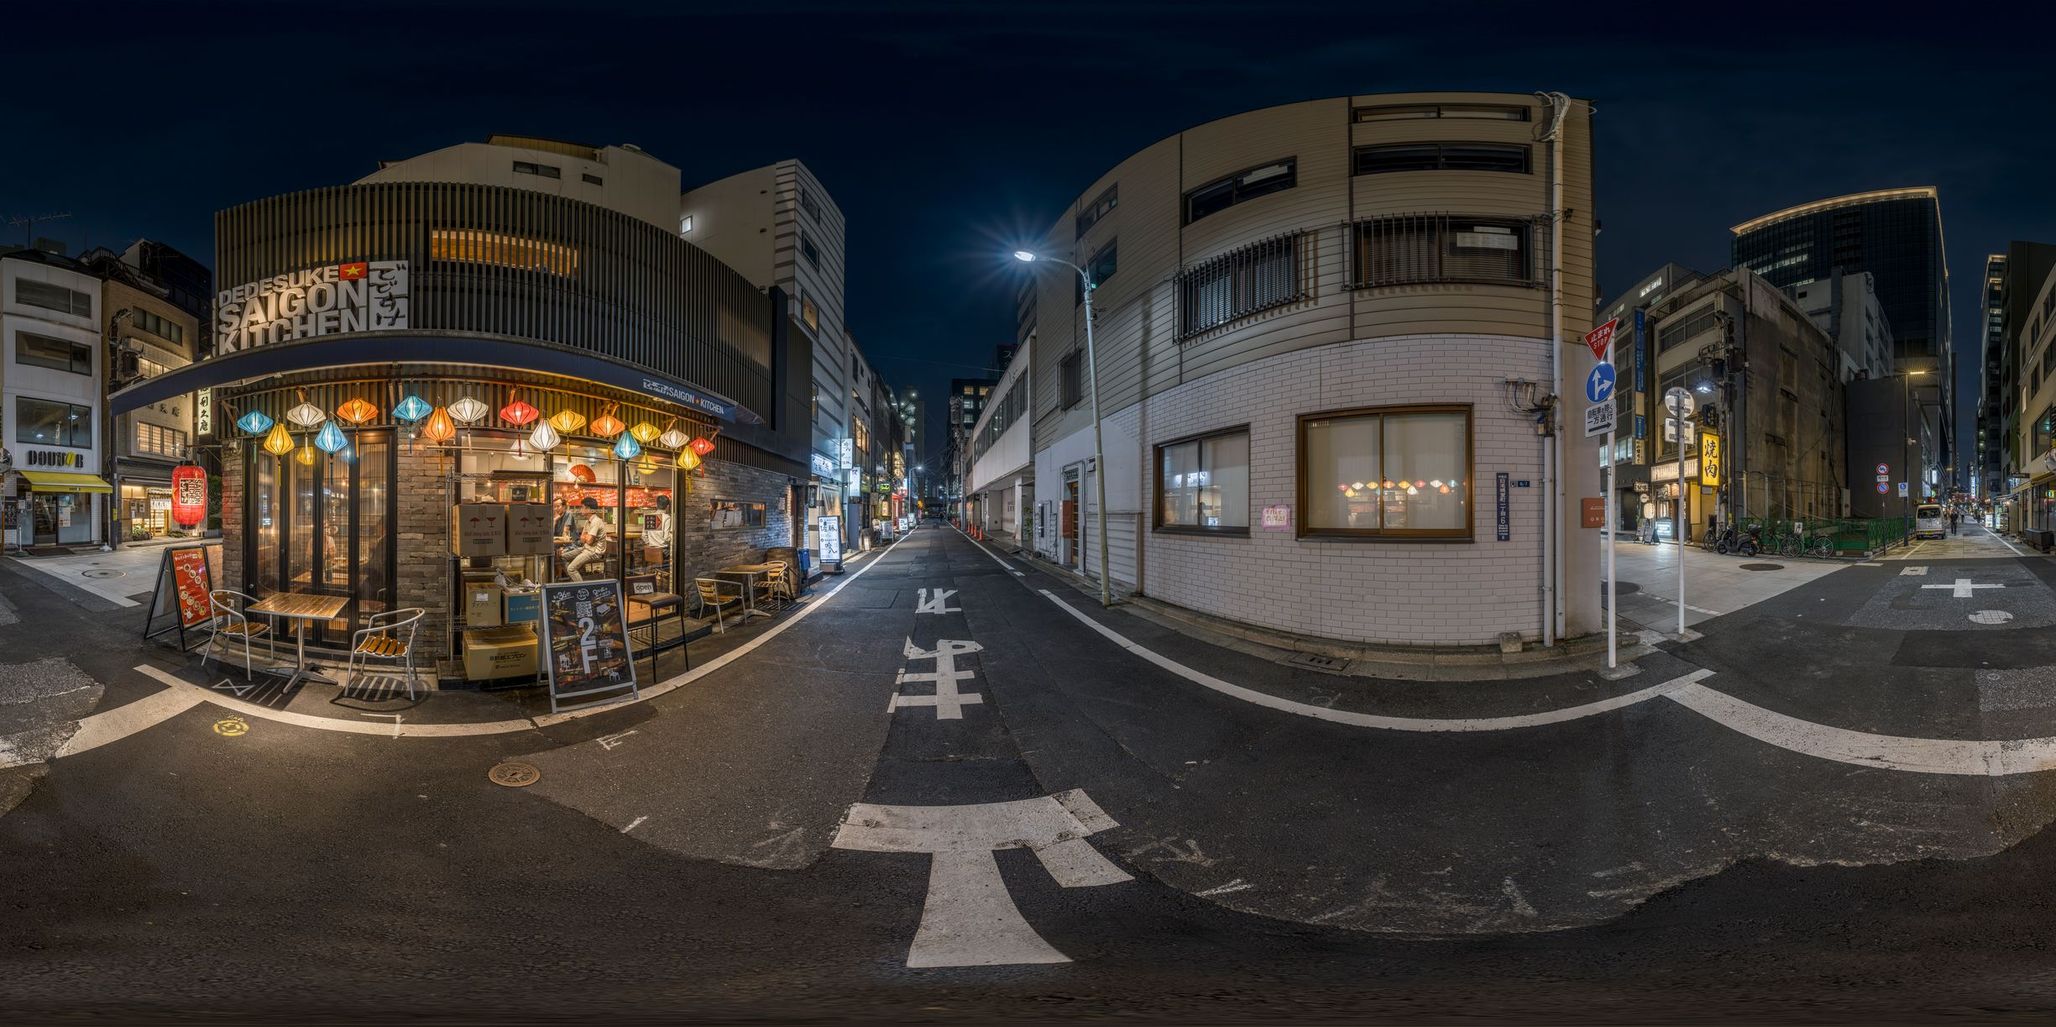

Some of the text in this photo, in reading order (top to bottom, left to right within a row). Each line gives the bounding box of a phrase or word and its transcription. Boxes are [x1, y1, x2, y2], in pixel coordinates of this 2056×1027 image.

[218, 265, 339, 306] DEDESUKE
[218, 278, 367, 335] SAIGON
[218, 307, 367, 356] KITCHEN
[1590, 326, 1610, 343] 止まれ
[1593, 336, 1608, 350] STOP
[668, 385, 695, 404] SAIGON
[700, 398, 725, 415] KITCHEN
[1587, 413, 1613, 425] 一方通行
[1704, 439, 1718, 479] 焼肉
[578, 617, 598, 674] 2F
